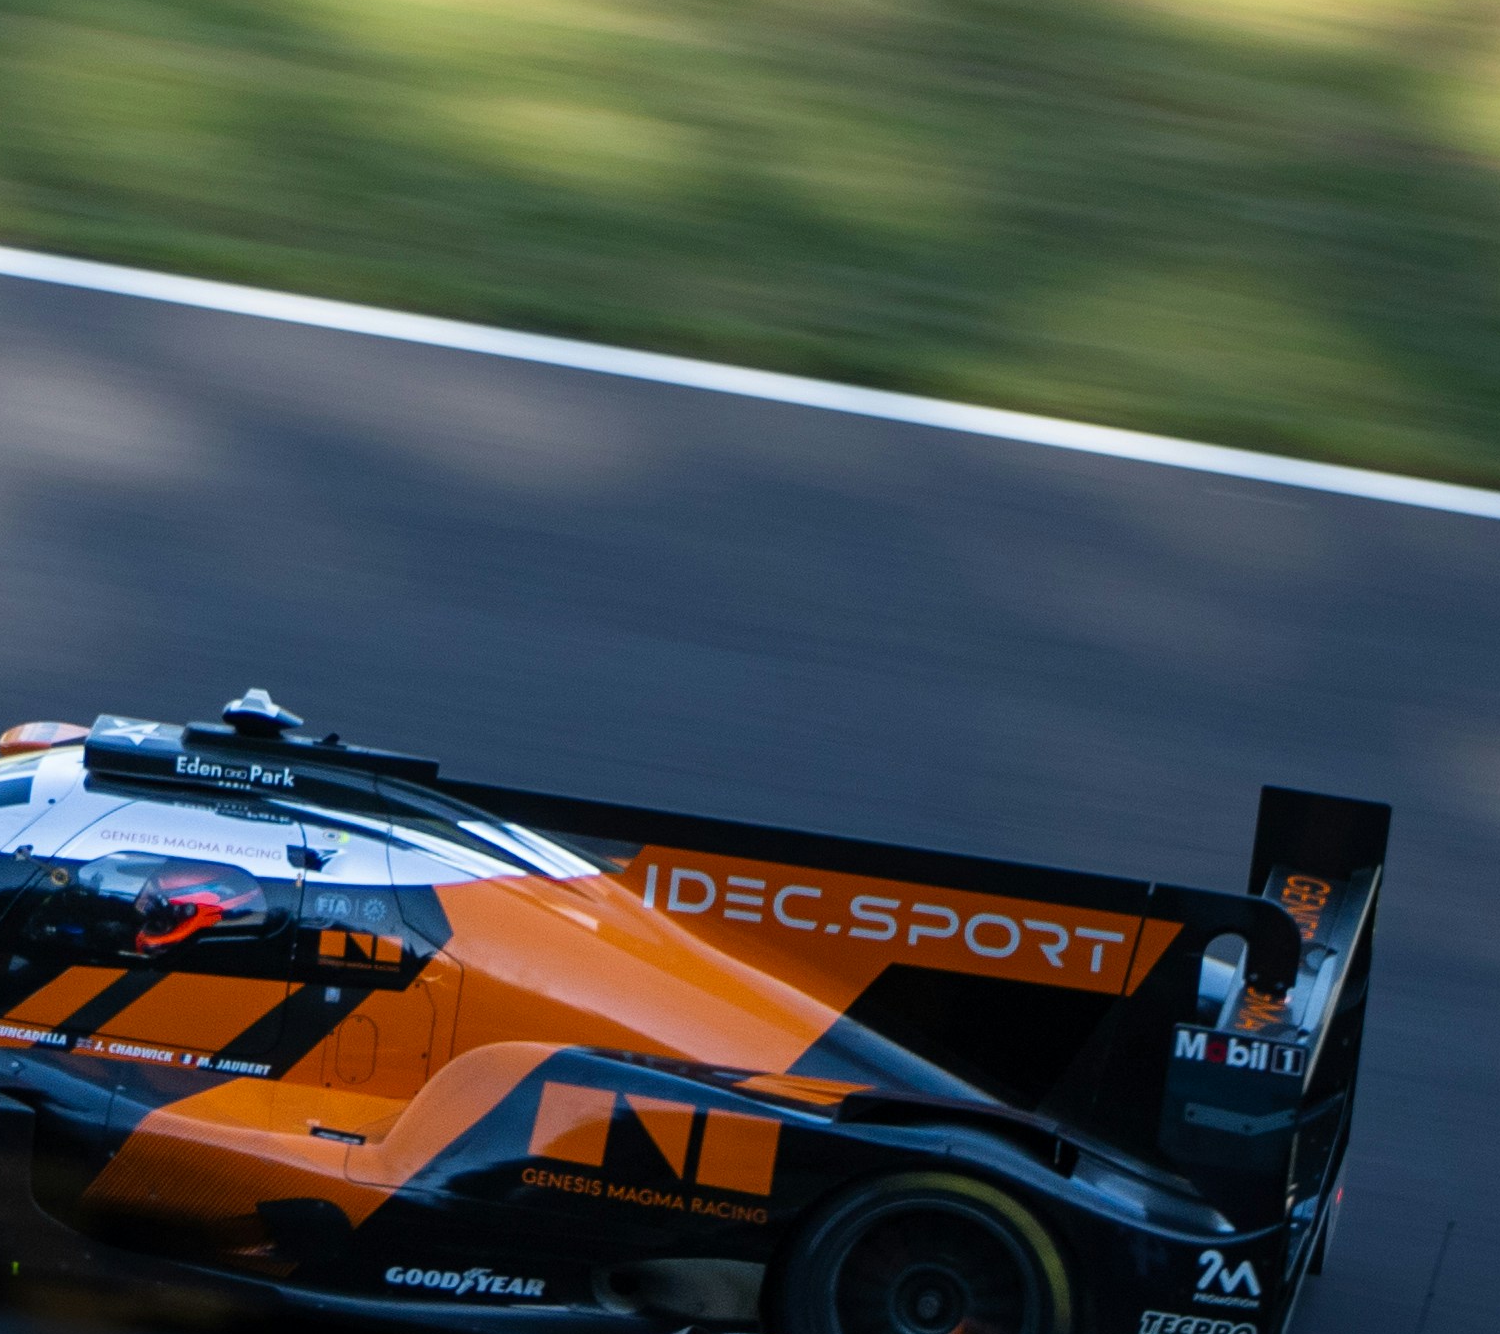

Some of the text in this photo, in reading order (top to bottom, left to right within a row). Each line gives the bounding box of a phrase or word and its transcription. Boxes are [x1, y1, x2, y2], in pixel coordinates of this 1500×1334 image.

[175, 755, 295, 788] Eden Park
[100, 828, 283, 862] GENESIS MAGMA RACING
[316, 896, 348, 917] FIA
[642, 863, 1126, 974] IDEC.SPORT
[94, 1040, 175, 1062] J. CHADWICK
[196, 1056, 272, 1076] M. JAUBERT
[1174, 1029, 1270, 1071] Mobil
[521, 1167, 769, 1225] GENESIS MAGMA RACING
[385, 1266, 547, 1297] GOODYEAR
